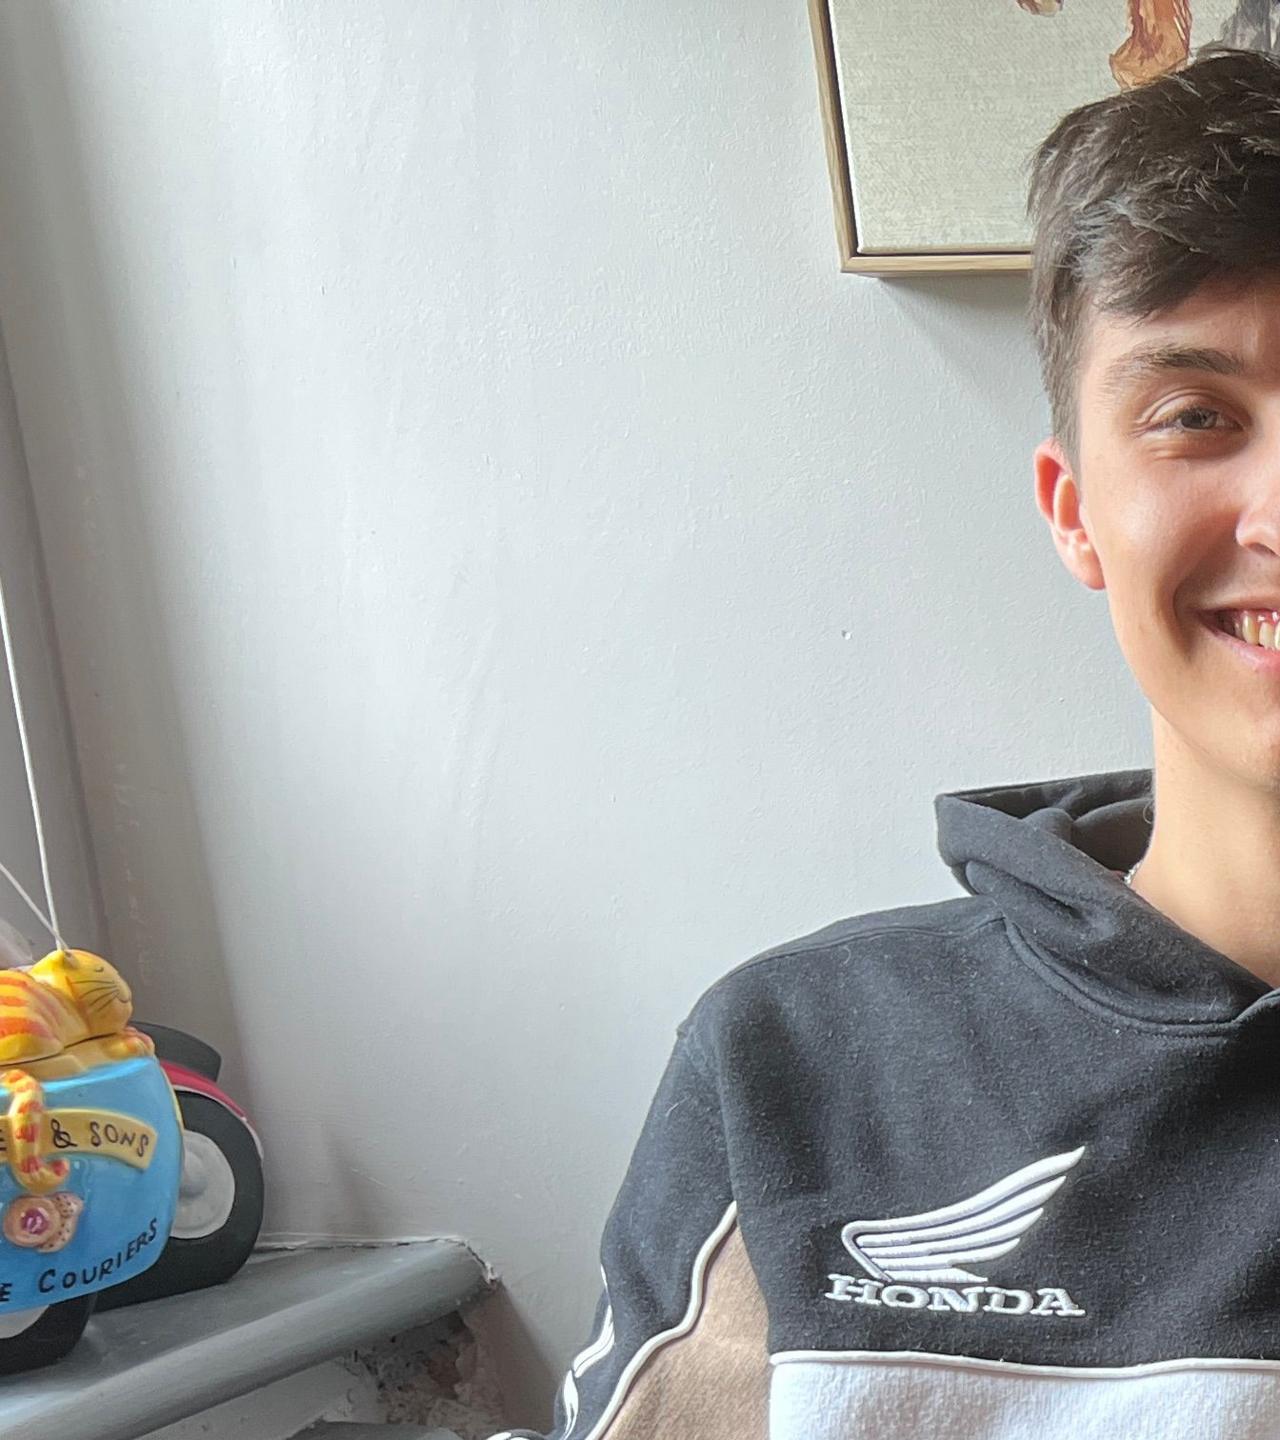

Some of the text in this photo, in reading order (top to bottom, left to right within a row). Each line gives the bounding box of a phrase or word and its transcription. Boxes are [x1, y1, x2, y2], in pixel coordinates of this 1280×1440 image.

[51, 1119, 149, 1157] & SONS
[38, 1218, 157, 1293] COURIERS
[824, 1273, 1086, 1317] HONDA
